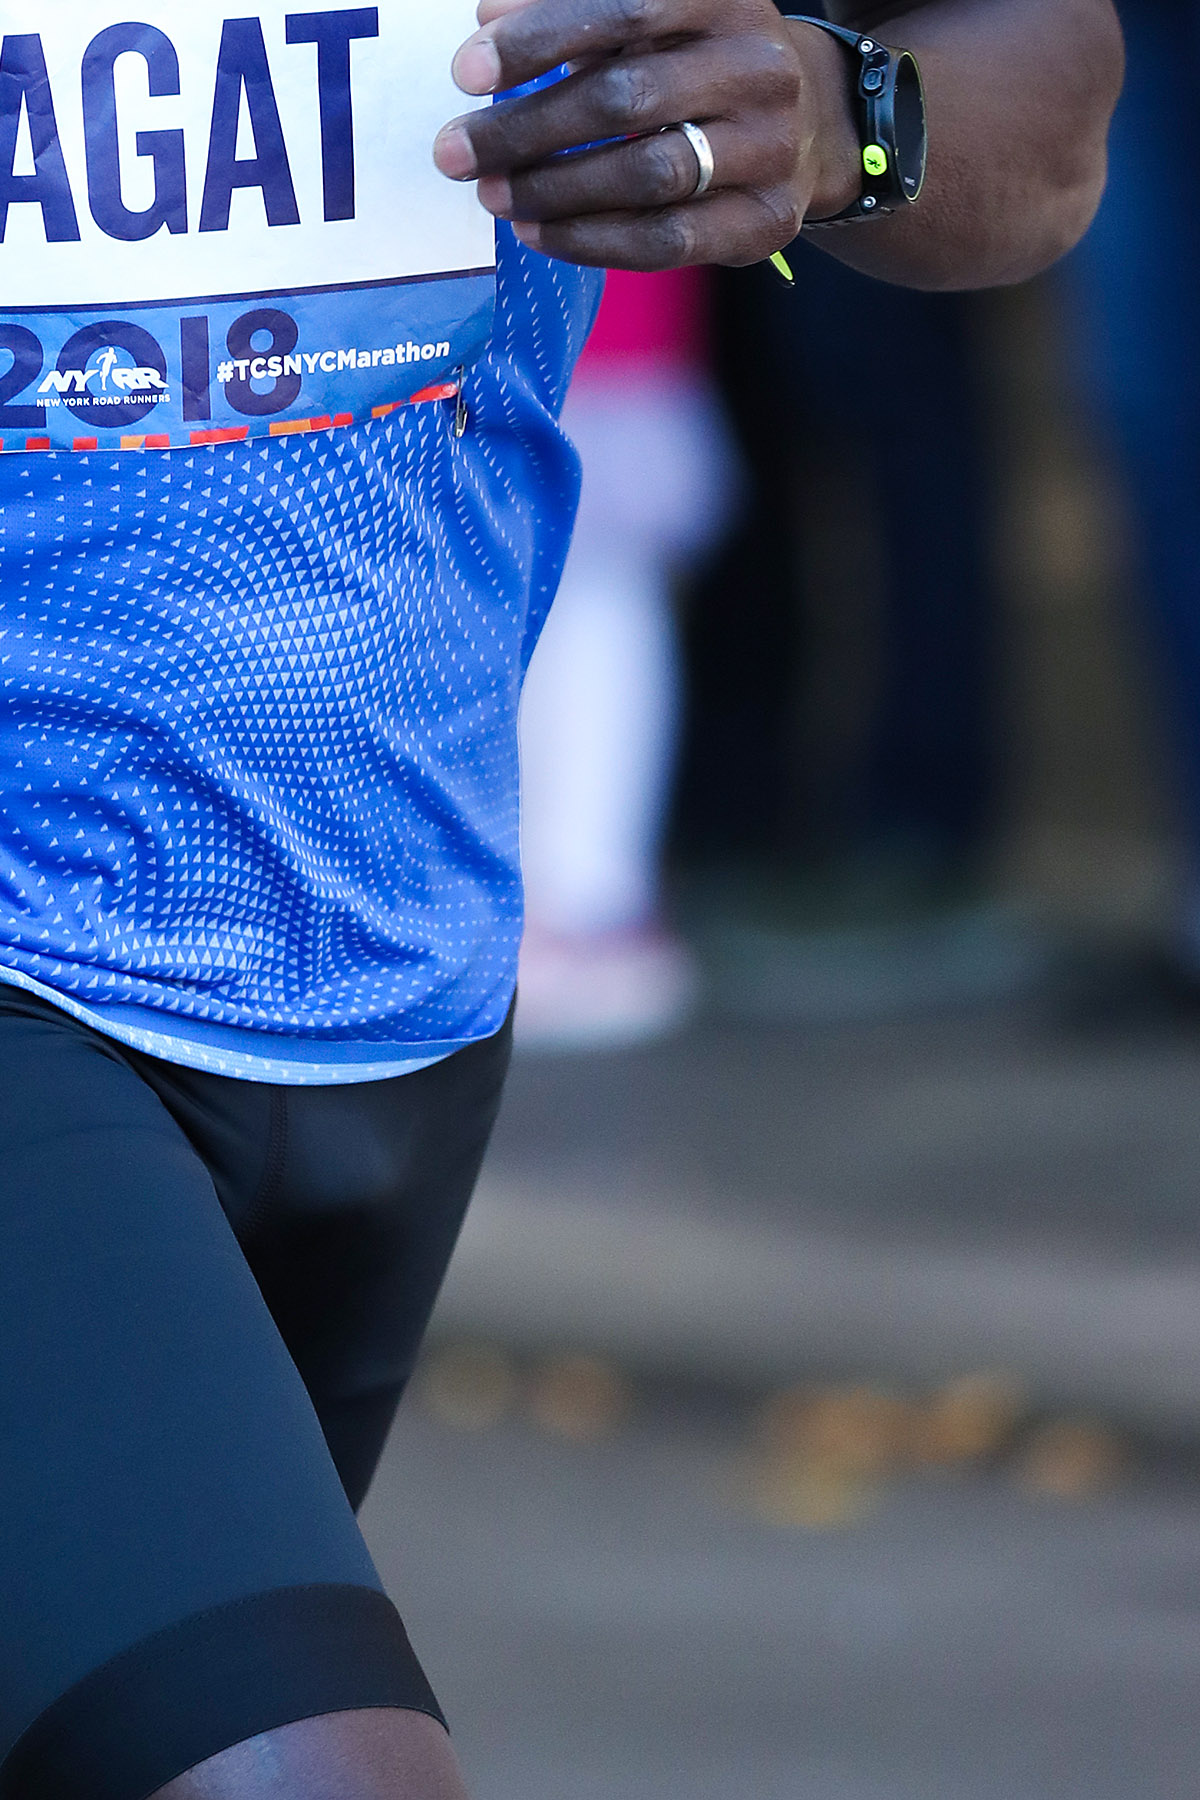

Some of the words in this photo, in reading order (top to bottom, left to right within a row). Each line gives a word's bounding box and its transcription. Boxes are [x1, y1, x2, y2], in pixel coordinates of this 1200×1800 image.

[216, 340, 450, 384] #TCSNYCMarathon
[36, 398, 60, 408] NEW
[63, 397, 90, 407] YORK
[92, 396, 121, 406] ROAD
[123, 394, 171, 405] RUNNERS
